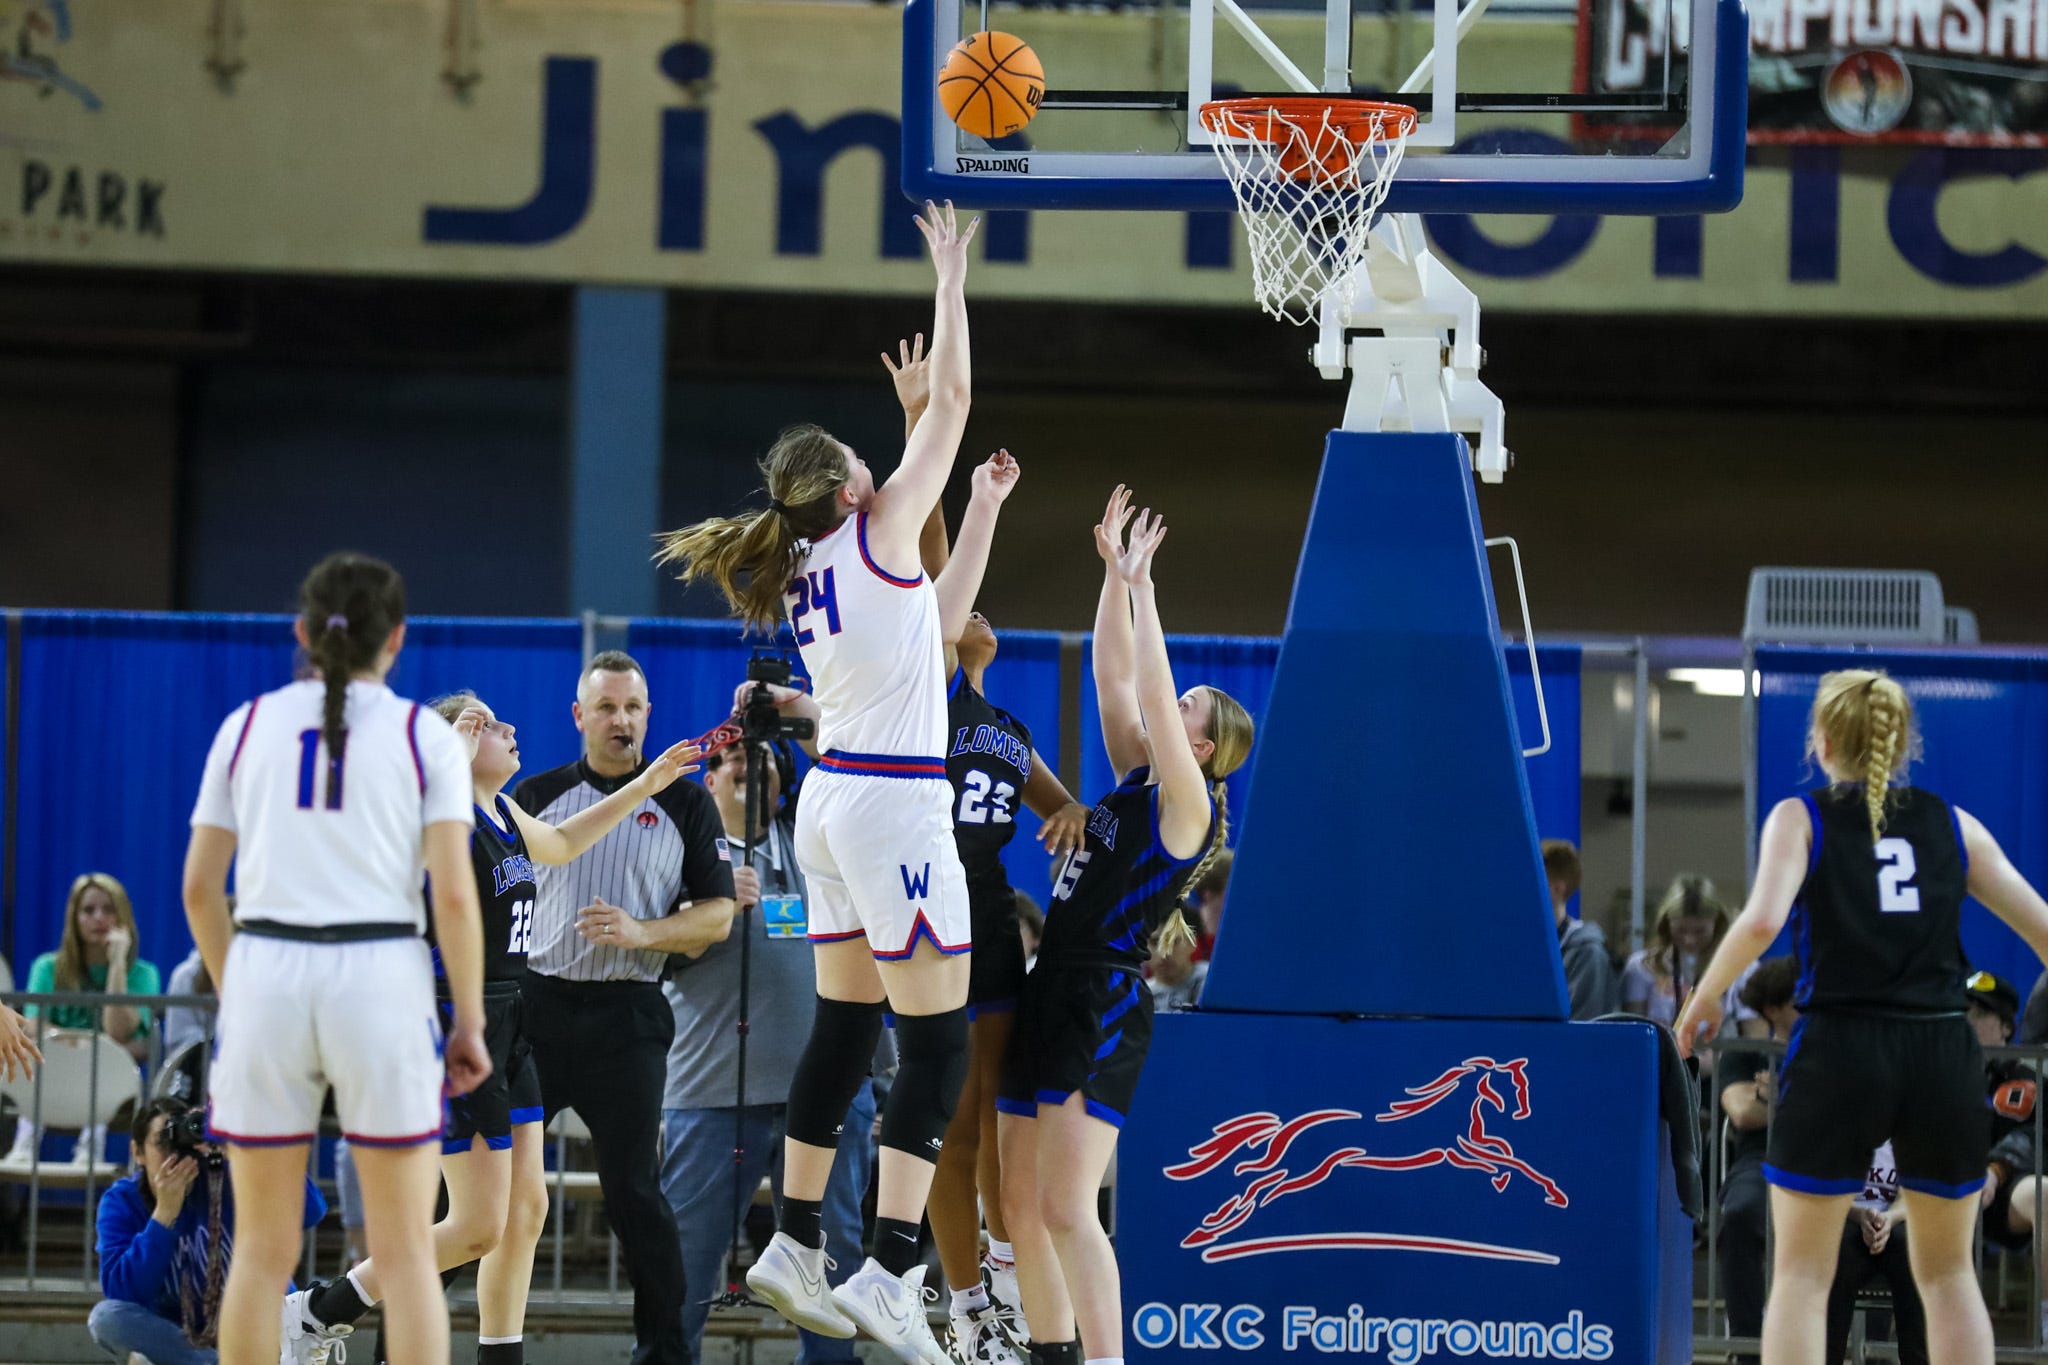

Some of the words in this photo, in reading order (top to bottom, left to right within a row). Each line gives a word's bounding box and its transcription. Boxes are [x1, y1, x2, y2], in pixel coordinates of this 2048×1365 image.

[956, 157, 1030, 174] SPALDING
[21, 160, 166, 239] PARK
[786, 565, 842, 647] 24
[900, 862, 930, 900] W
[1874, 836, 1920, 912] 2
[507, 899, 534, 953] 22
[1132, 1302, 1265, 1350] OKC
[1282, 1303, 1614, 1365] Fairgrounds
